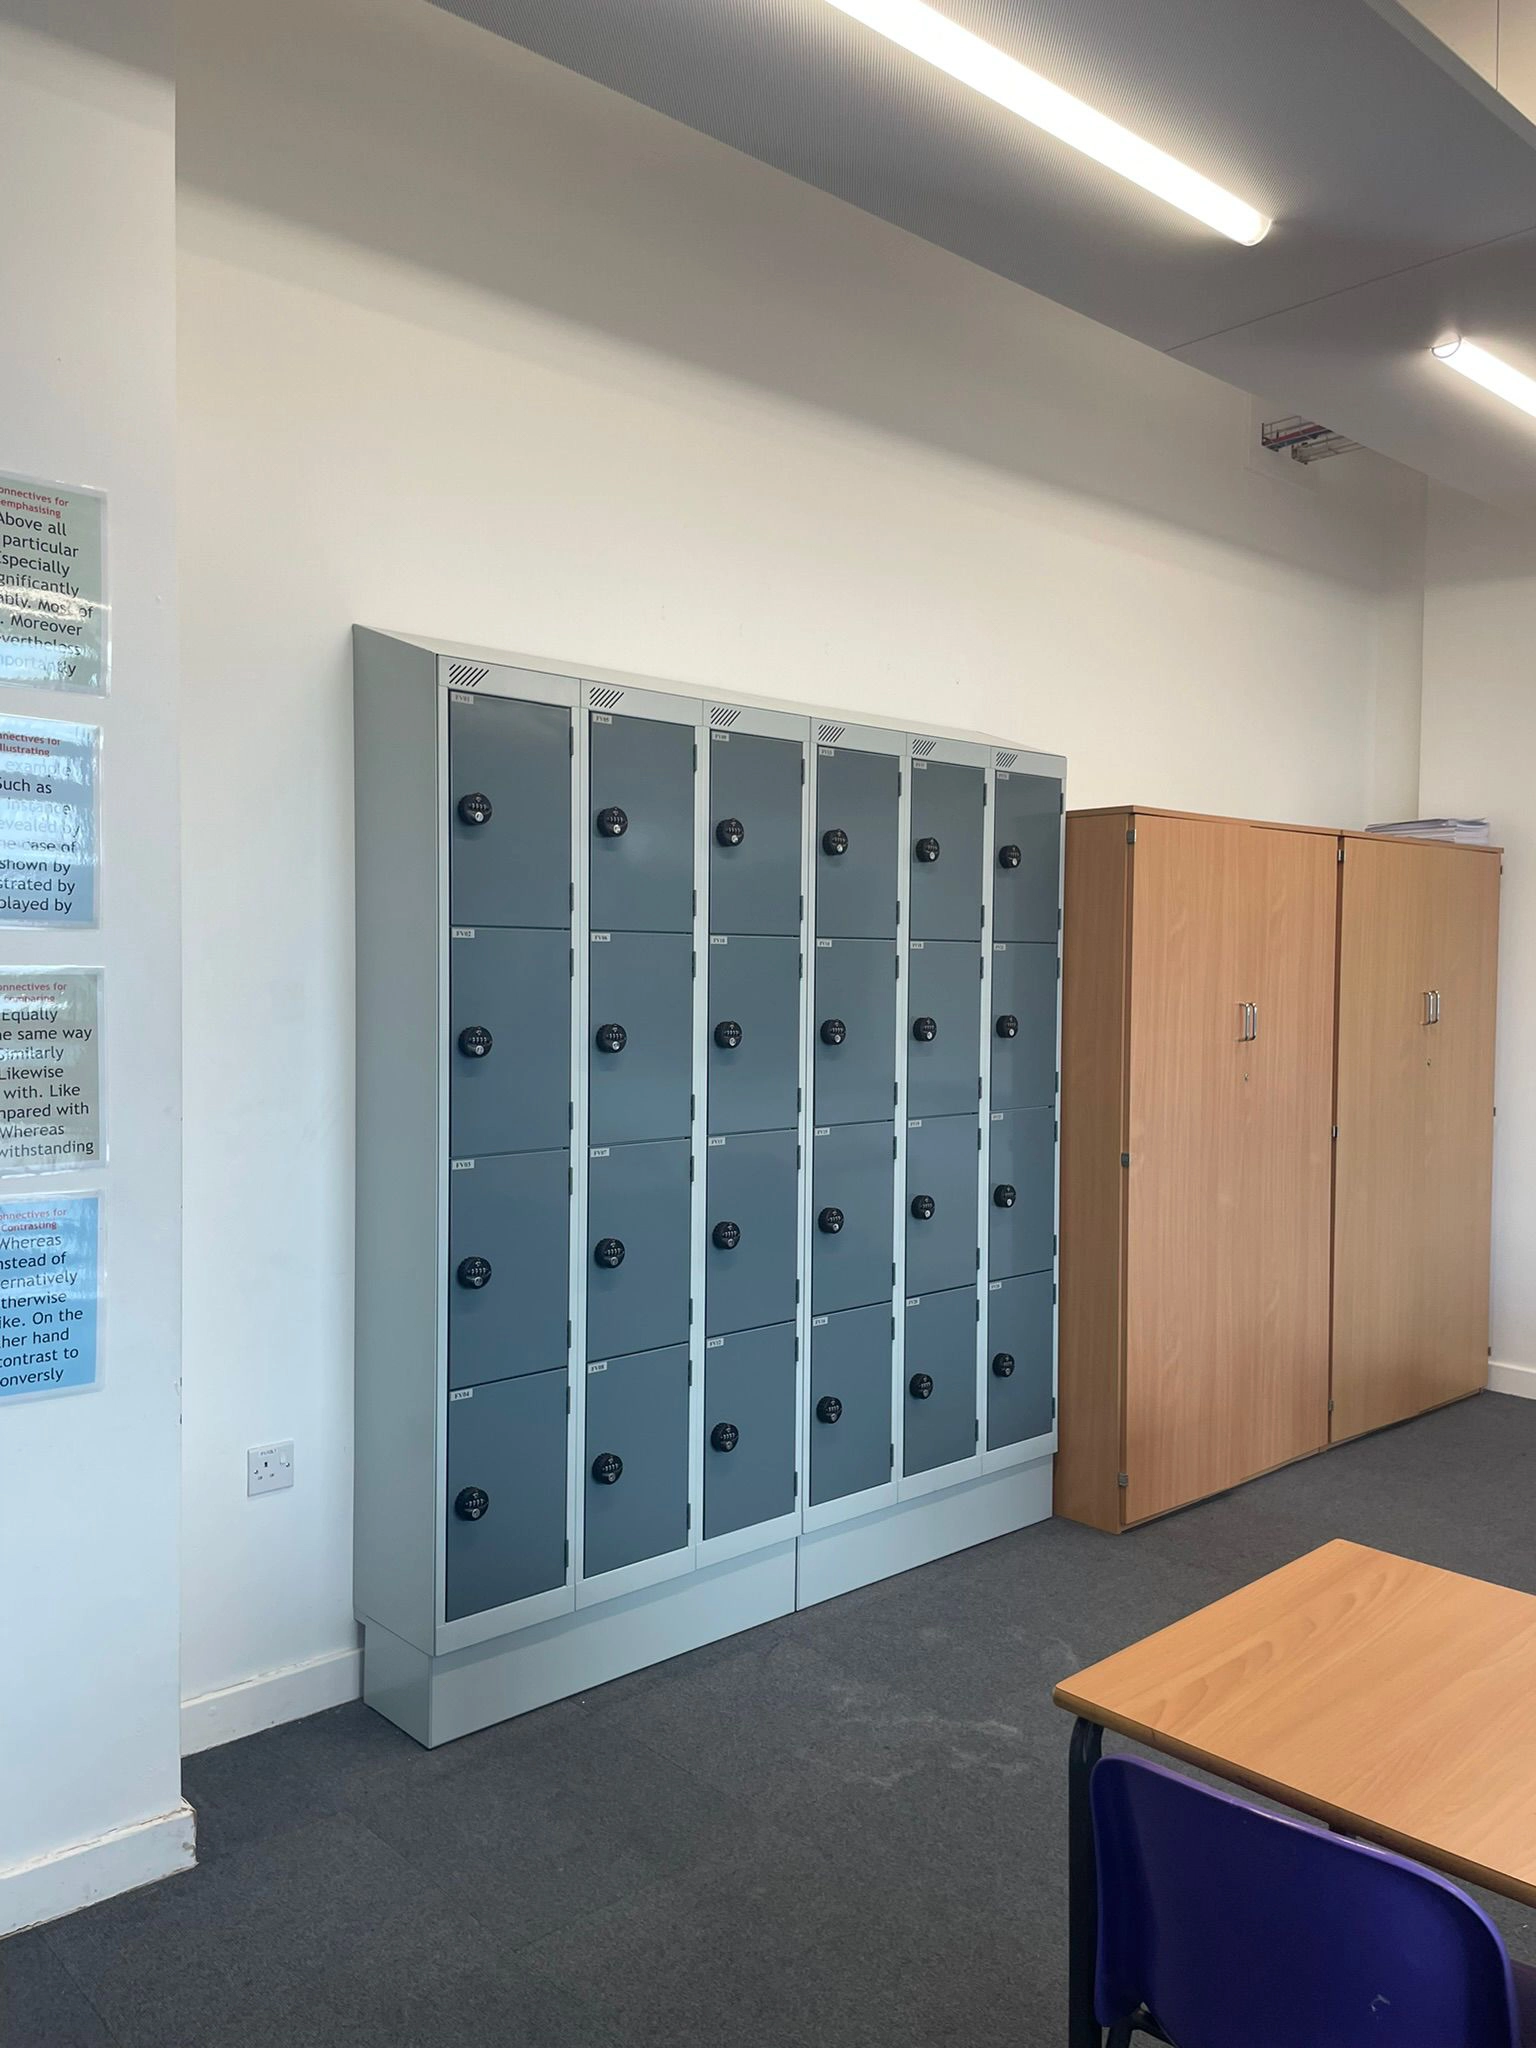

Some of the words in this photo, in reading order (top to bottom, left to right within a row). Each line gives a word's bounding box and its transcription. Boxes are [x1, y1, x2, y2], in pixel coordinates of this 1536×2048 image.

[1, 499, 62, 519] emphasising
[55, 496, 69, 507] for
[0, 511, 42, 532] Above
[48, 522, 67, 537] all
[3, 533, 79, 558] particular
[38, 599, 72, 615] Mos
[78, 605, 94, 618] of
[11, 615, 83, 636] Moreover
[0, 634, 81, 656] vertheless
[36, 783, 52, 795] as
[63, 818, 80, 838] by
[61, 840, 77, 853] of
[0, 858, 48, 872] shown
[53, 859, 71, 876] by
[58, 878, 76, 896] by
[55, 897, 73, 915] by
[53, 982, 68, 992] for
[2, 1007, 59, 1024] Equally
[17, 1028, 57, 1041] same
[63, 1027, 93, 1042] way
[4, 1084, 43, 1099] with.
[50, 1084, 81, 1097] Like
[56, 1101, 89, 1116] with
[0, 1124, 65, 1139] Whereas
[53, 1208, 67, 1218] for
[1, 1221, 57, 1233] Contrasting
[0, 1234, 62, 1250] Whereas
[51, 1251, 67, 1265] of
[1, 1270, 78, 1290] ernatively
[1, 1292, 67, 1310] therwise
[32, 1311, 53, 1326] On
[59, 1308, 83, 1322] the
[0, 1332, 27, 1348] her
[33, 1328, 70, 1345] hand
[64, 1347, 79, 1360] to
[0, 1367, 64, 1388] onversly
